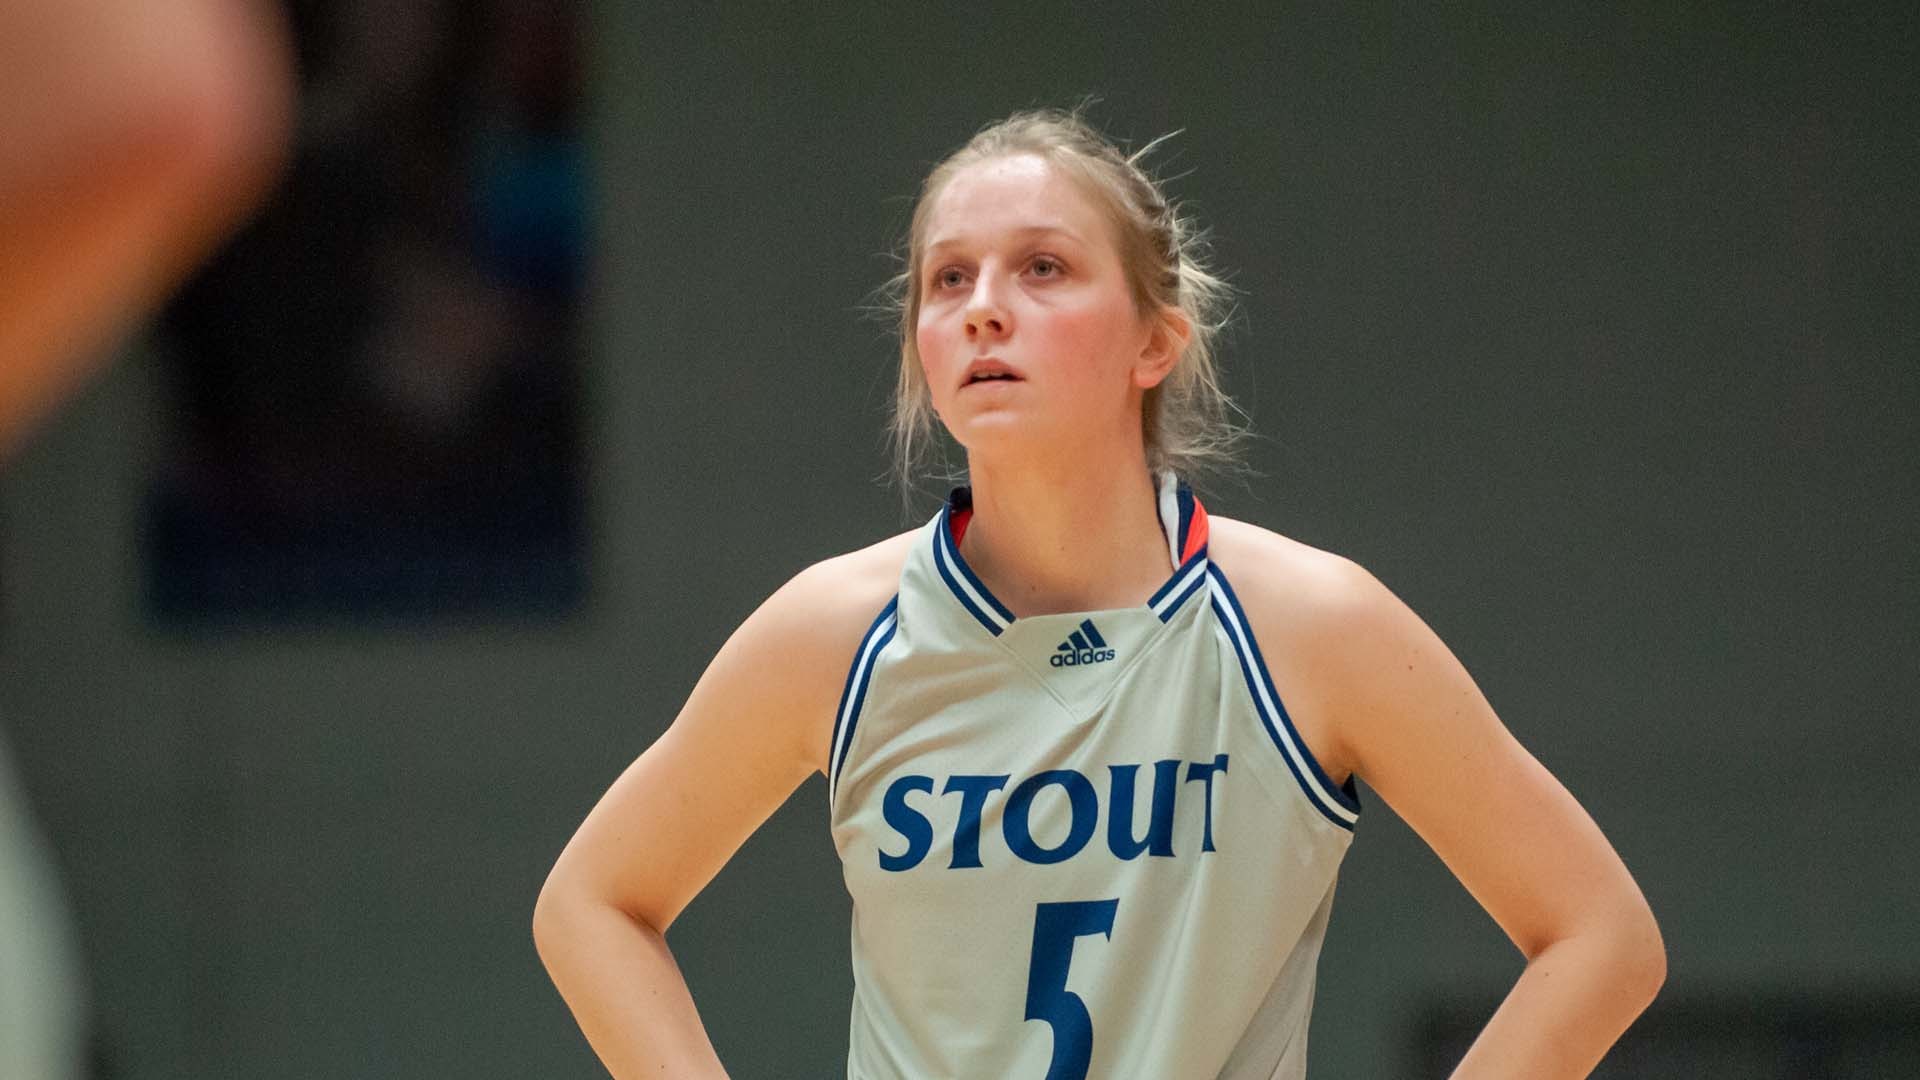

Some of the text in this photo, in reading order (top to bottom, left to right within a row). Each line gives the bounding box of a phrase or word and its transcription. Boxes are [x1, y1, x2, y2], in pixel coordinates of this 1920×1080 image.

[1050, 648, 1116, 667] adidas
[878, 754, 1229, 872] STOUT
[1024, 898, 1120, 1080] 5
